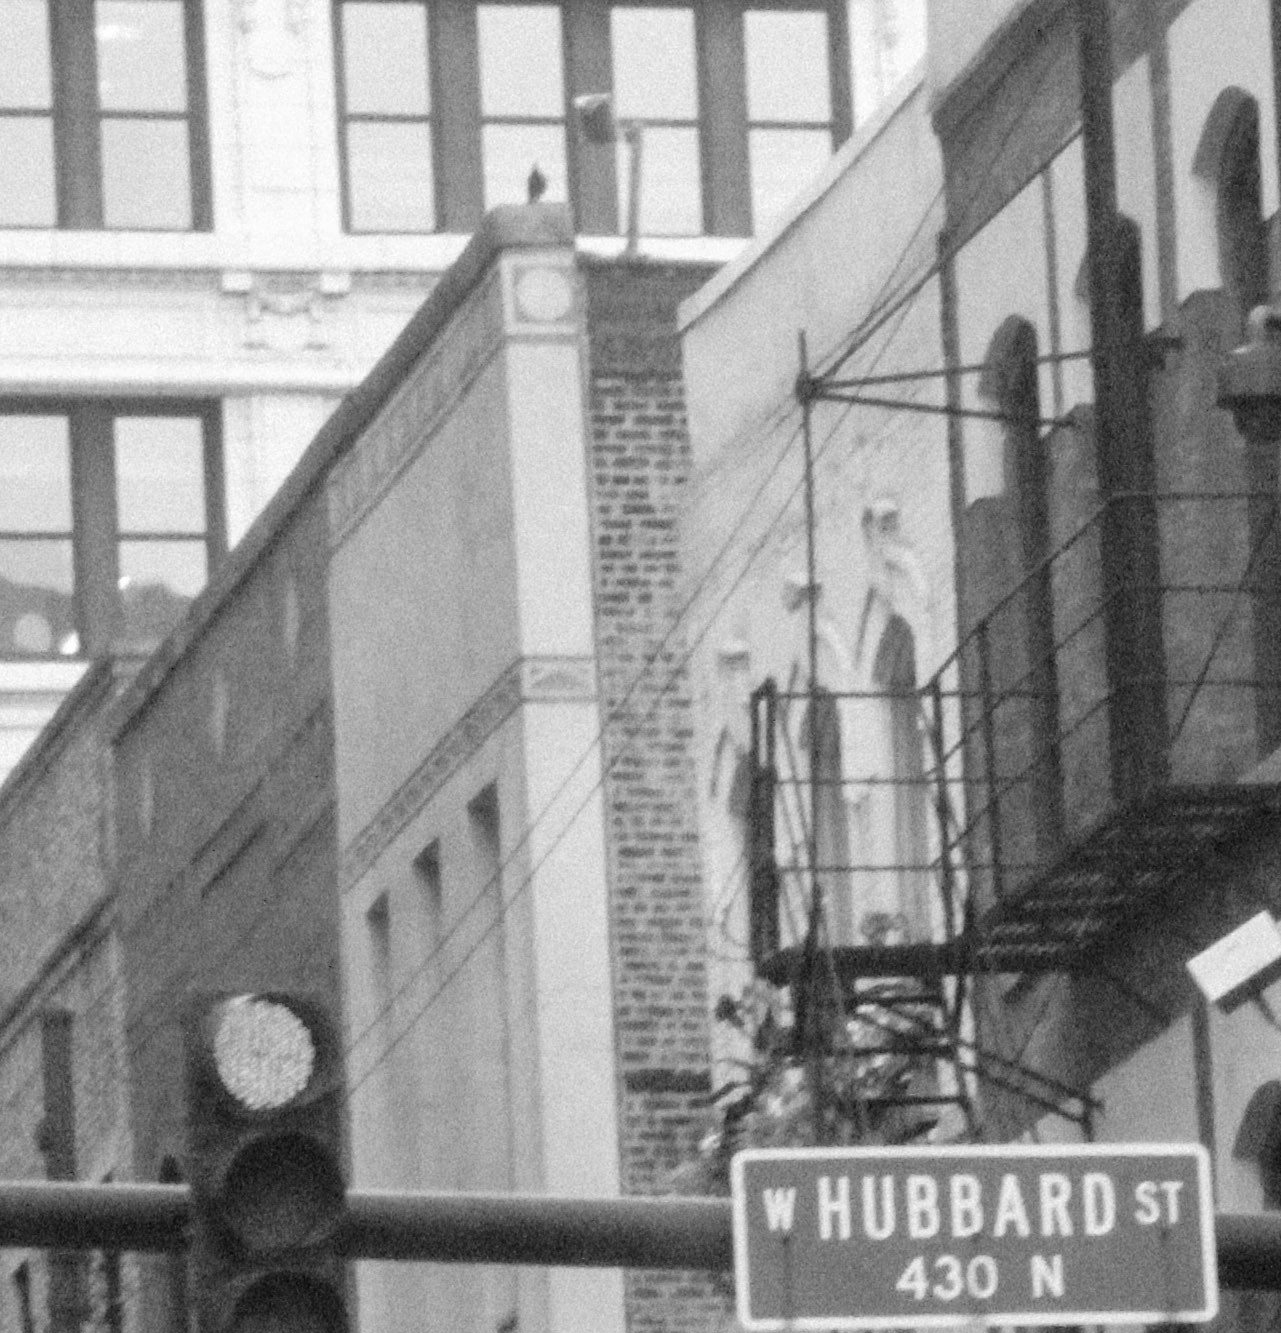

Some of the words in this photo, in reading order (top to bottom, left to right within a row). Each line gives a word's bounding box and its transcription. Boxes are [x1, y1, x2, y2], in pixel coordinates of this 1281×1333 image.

[764, 1187, 796, 1232] W
[818, 1172, 1119, 1241] HUBBARD
[1135, 1180, 1184, 1226] ST
[897, 1256, 998, 1302] 430
[1032, 1257, 1063, 1297] N
